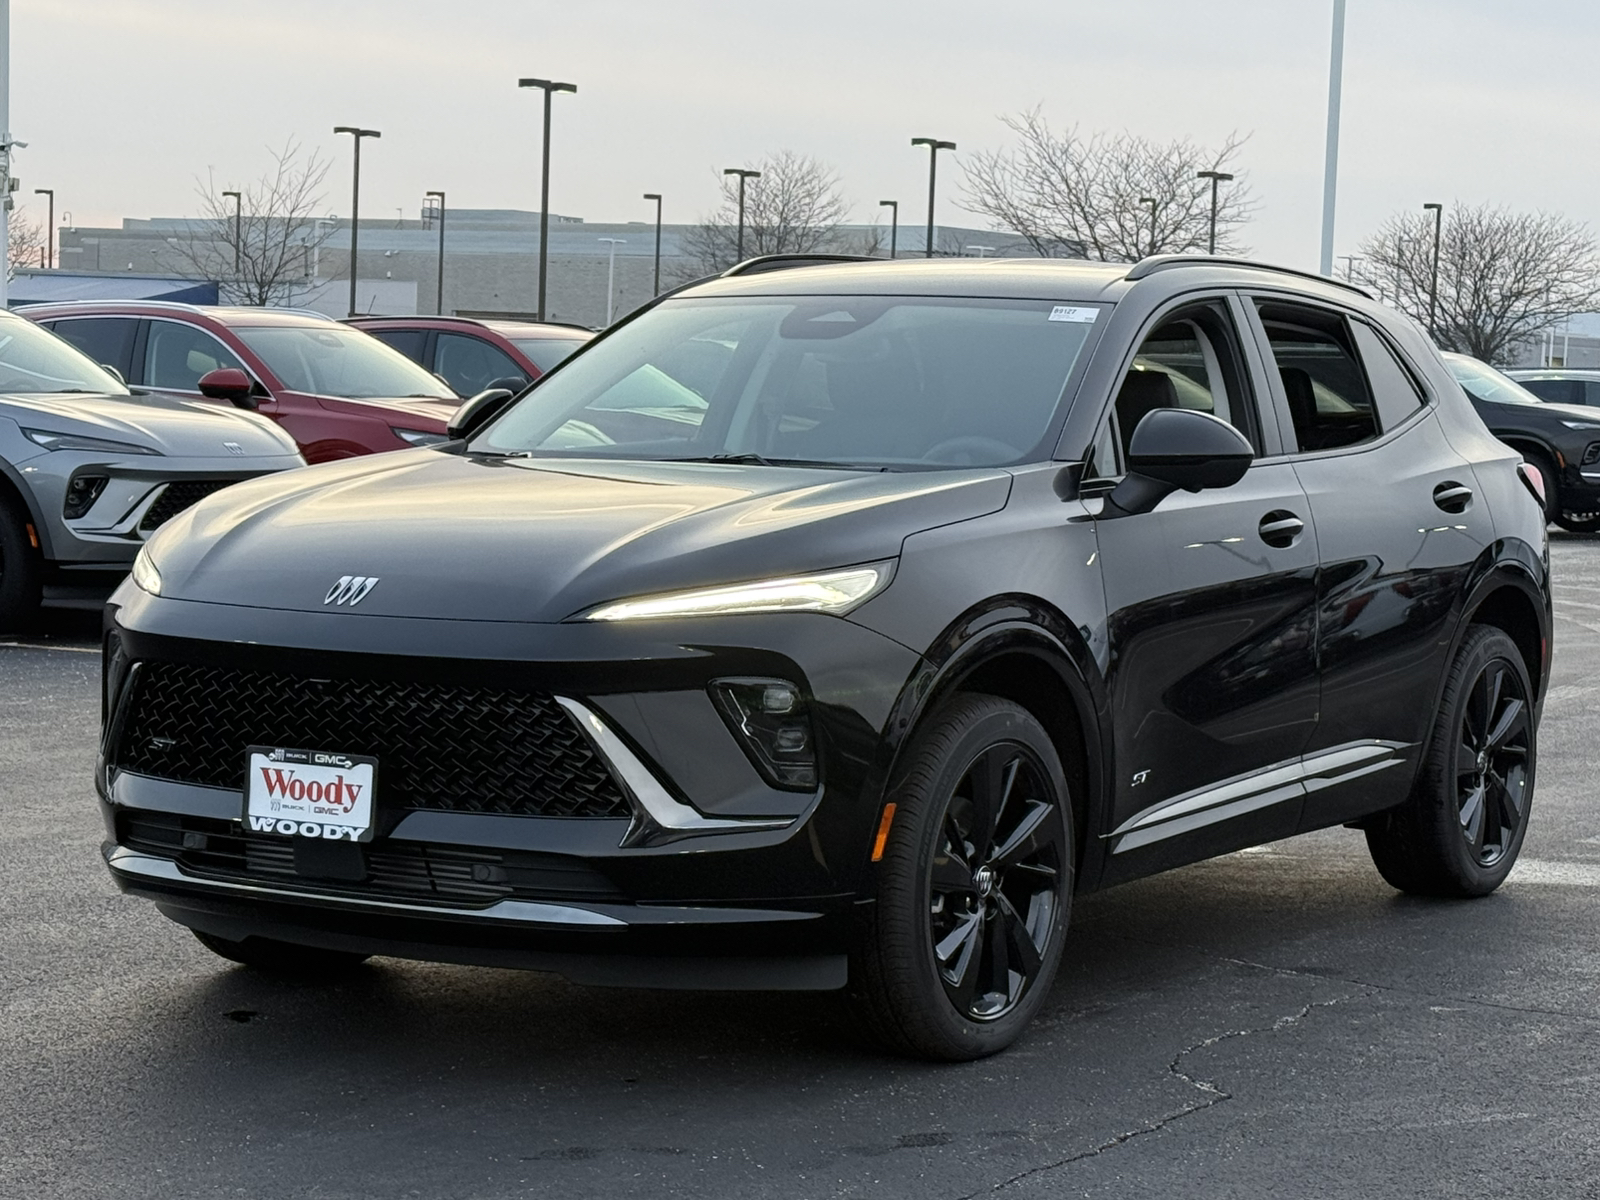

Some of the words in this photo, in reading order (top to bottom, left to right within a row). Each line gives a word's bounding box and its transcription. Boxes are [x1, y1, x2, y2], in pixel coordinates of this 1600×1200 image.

[315, 753, 347, 765] GMC
[1131, 769, 1151, 786] ST
[259, 767, 363, 814] Woody
[314, 806, 340, 816] GMC
[249, 816, 366, 842] WOODY
